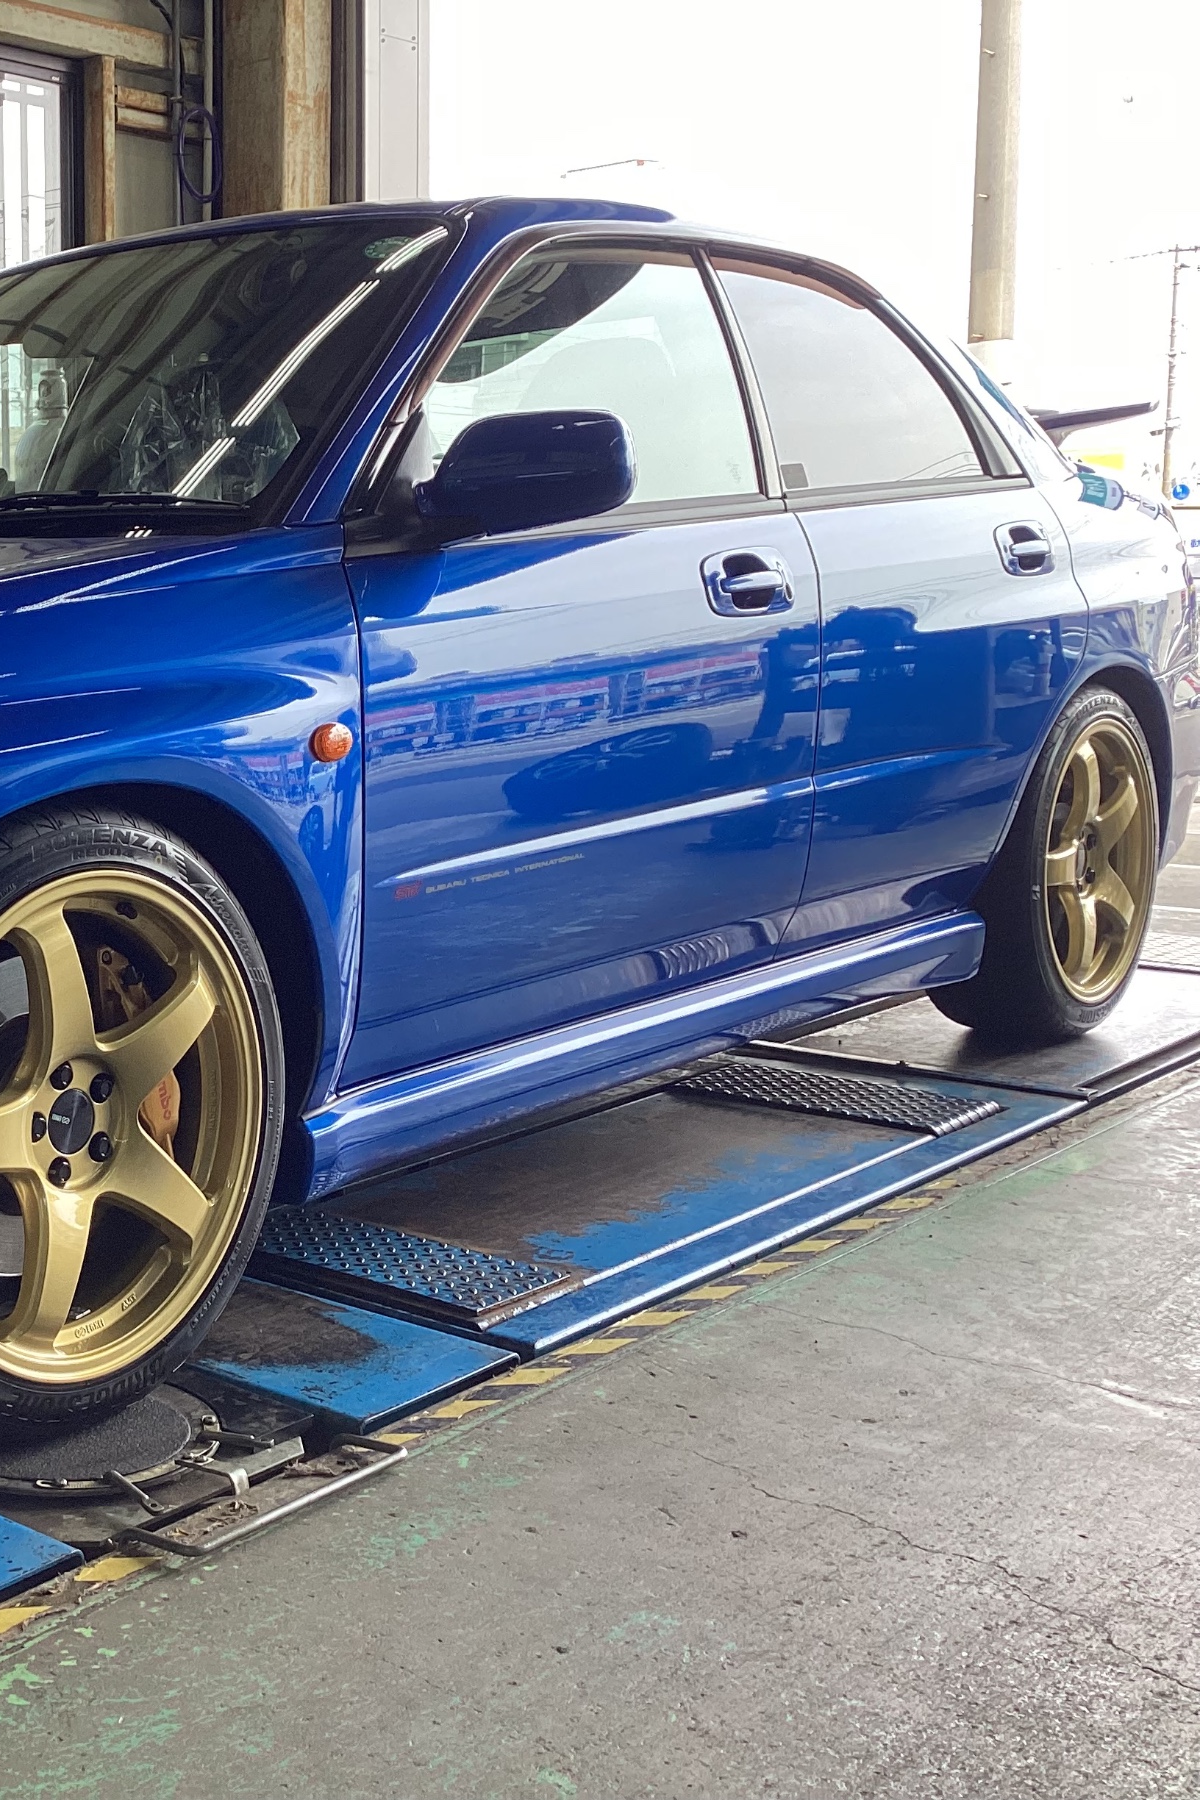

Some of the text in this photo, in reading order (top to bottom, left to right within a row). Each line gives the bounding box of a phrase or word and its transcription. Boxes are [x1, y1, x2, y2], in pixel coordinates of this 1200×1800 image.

[1075, 696, 1119, 720] POTENZA
[31, 827, 168, 862] POTENZA
[73, 847, 133, 862] RE004
[425, 878, 466, 894] SUBARU
[470, 869, 509, 883] TECNICA
[515, 853, 585, 873] INTERNATIONAL
